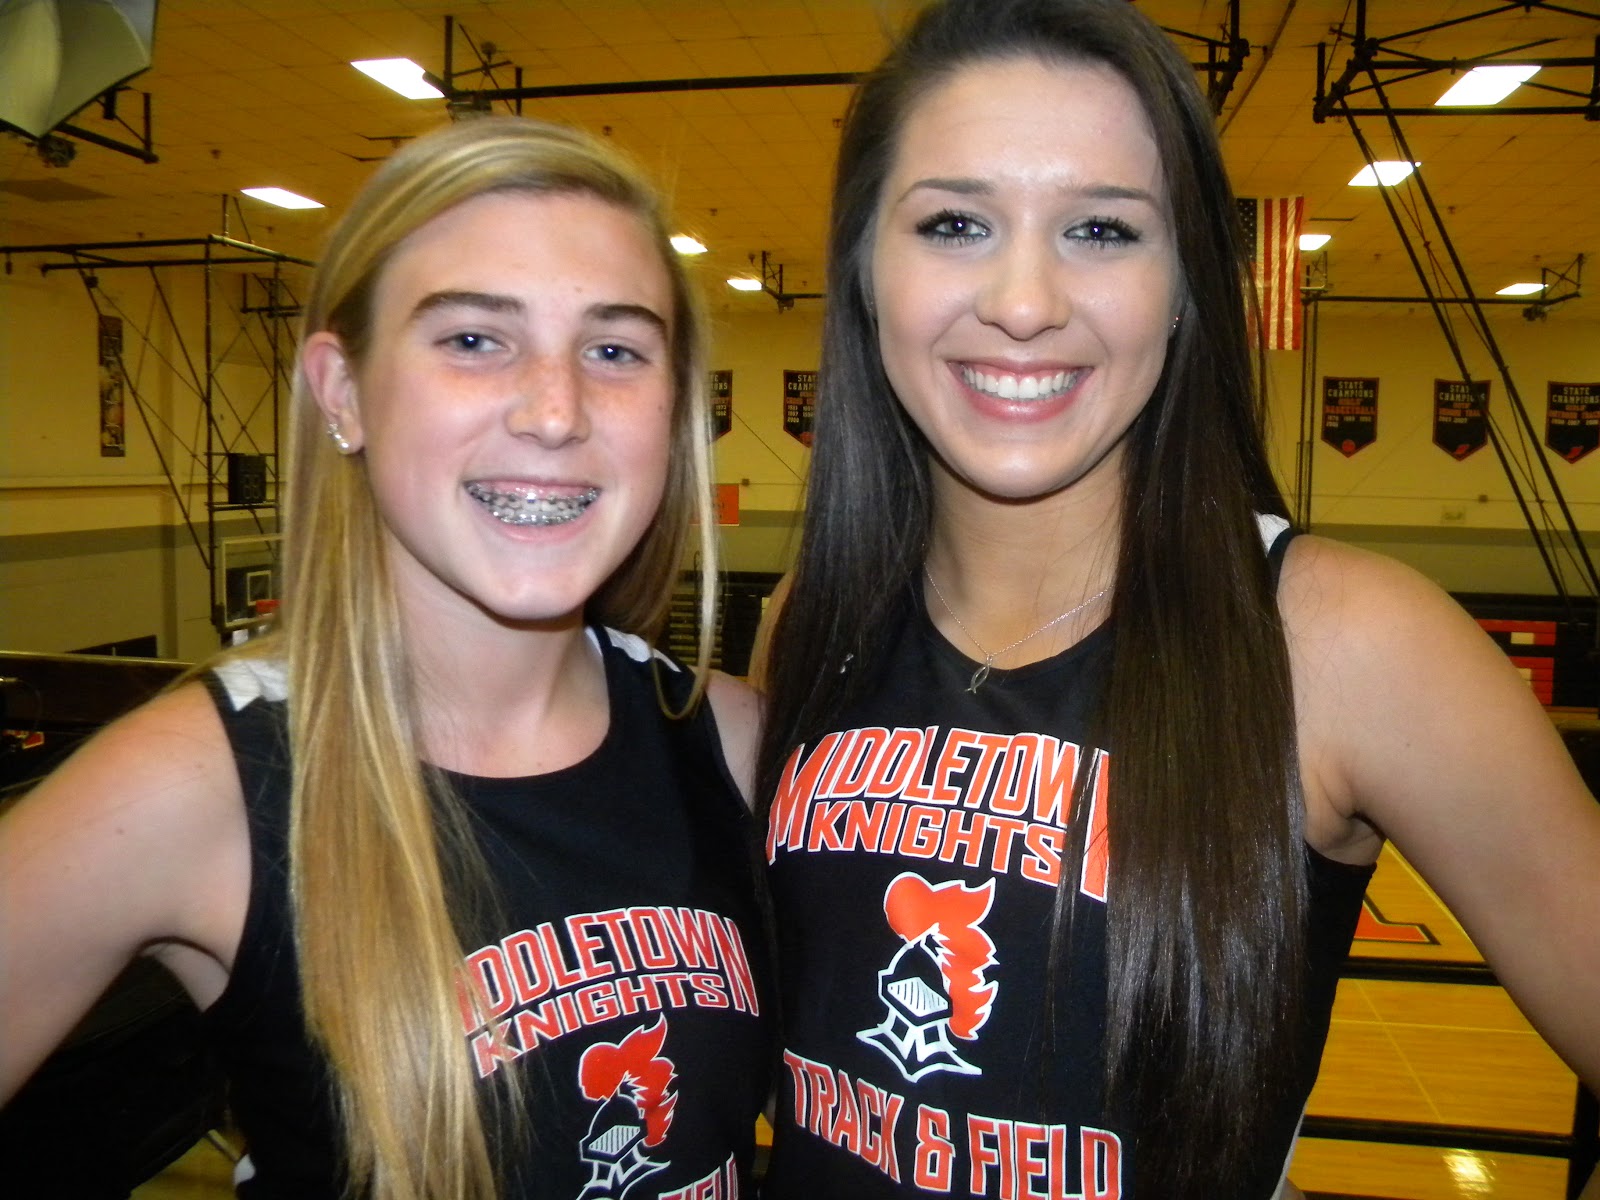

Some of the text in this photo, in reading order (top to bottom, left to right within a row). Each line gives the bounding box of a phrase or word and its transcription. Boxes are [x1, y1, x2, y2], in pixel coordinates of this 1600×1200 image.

[1327, 389, 1374, 398] CHAMPIONS
[1338, 381, 1364, 389] STATE
[1552, 394, 1600, 404] CHAMPIONS
[1563, 387, 1590, 395] STATE
[807, 800, 1067, 888] KNIGHTS
[453, 906, 760, 1037] IDDLETOWN
[470, 973, 730, 1079] KNIGHTS
[783, 1048, 904, 1184] TRACK
[914, 1104, 956, 1192] &
[967, 1113, 1122, 1200] FIELD
